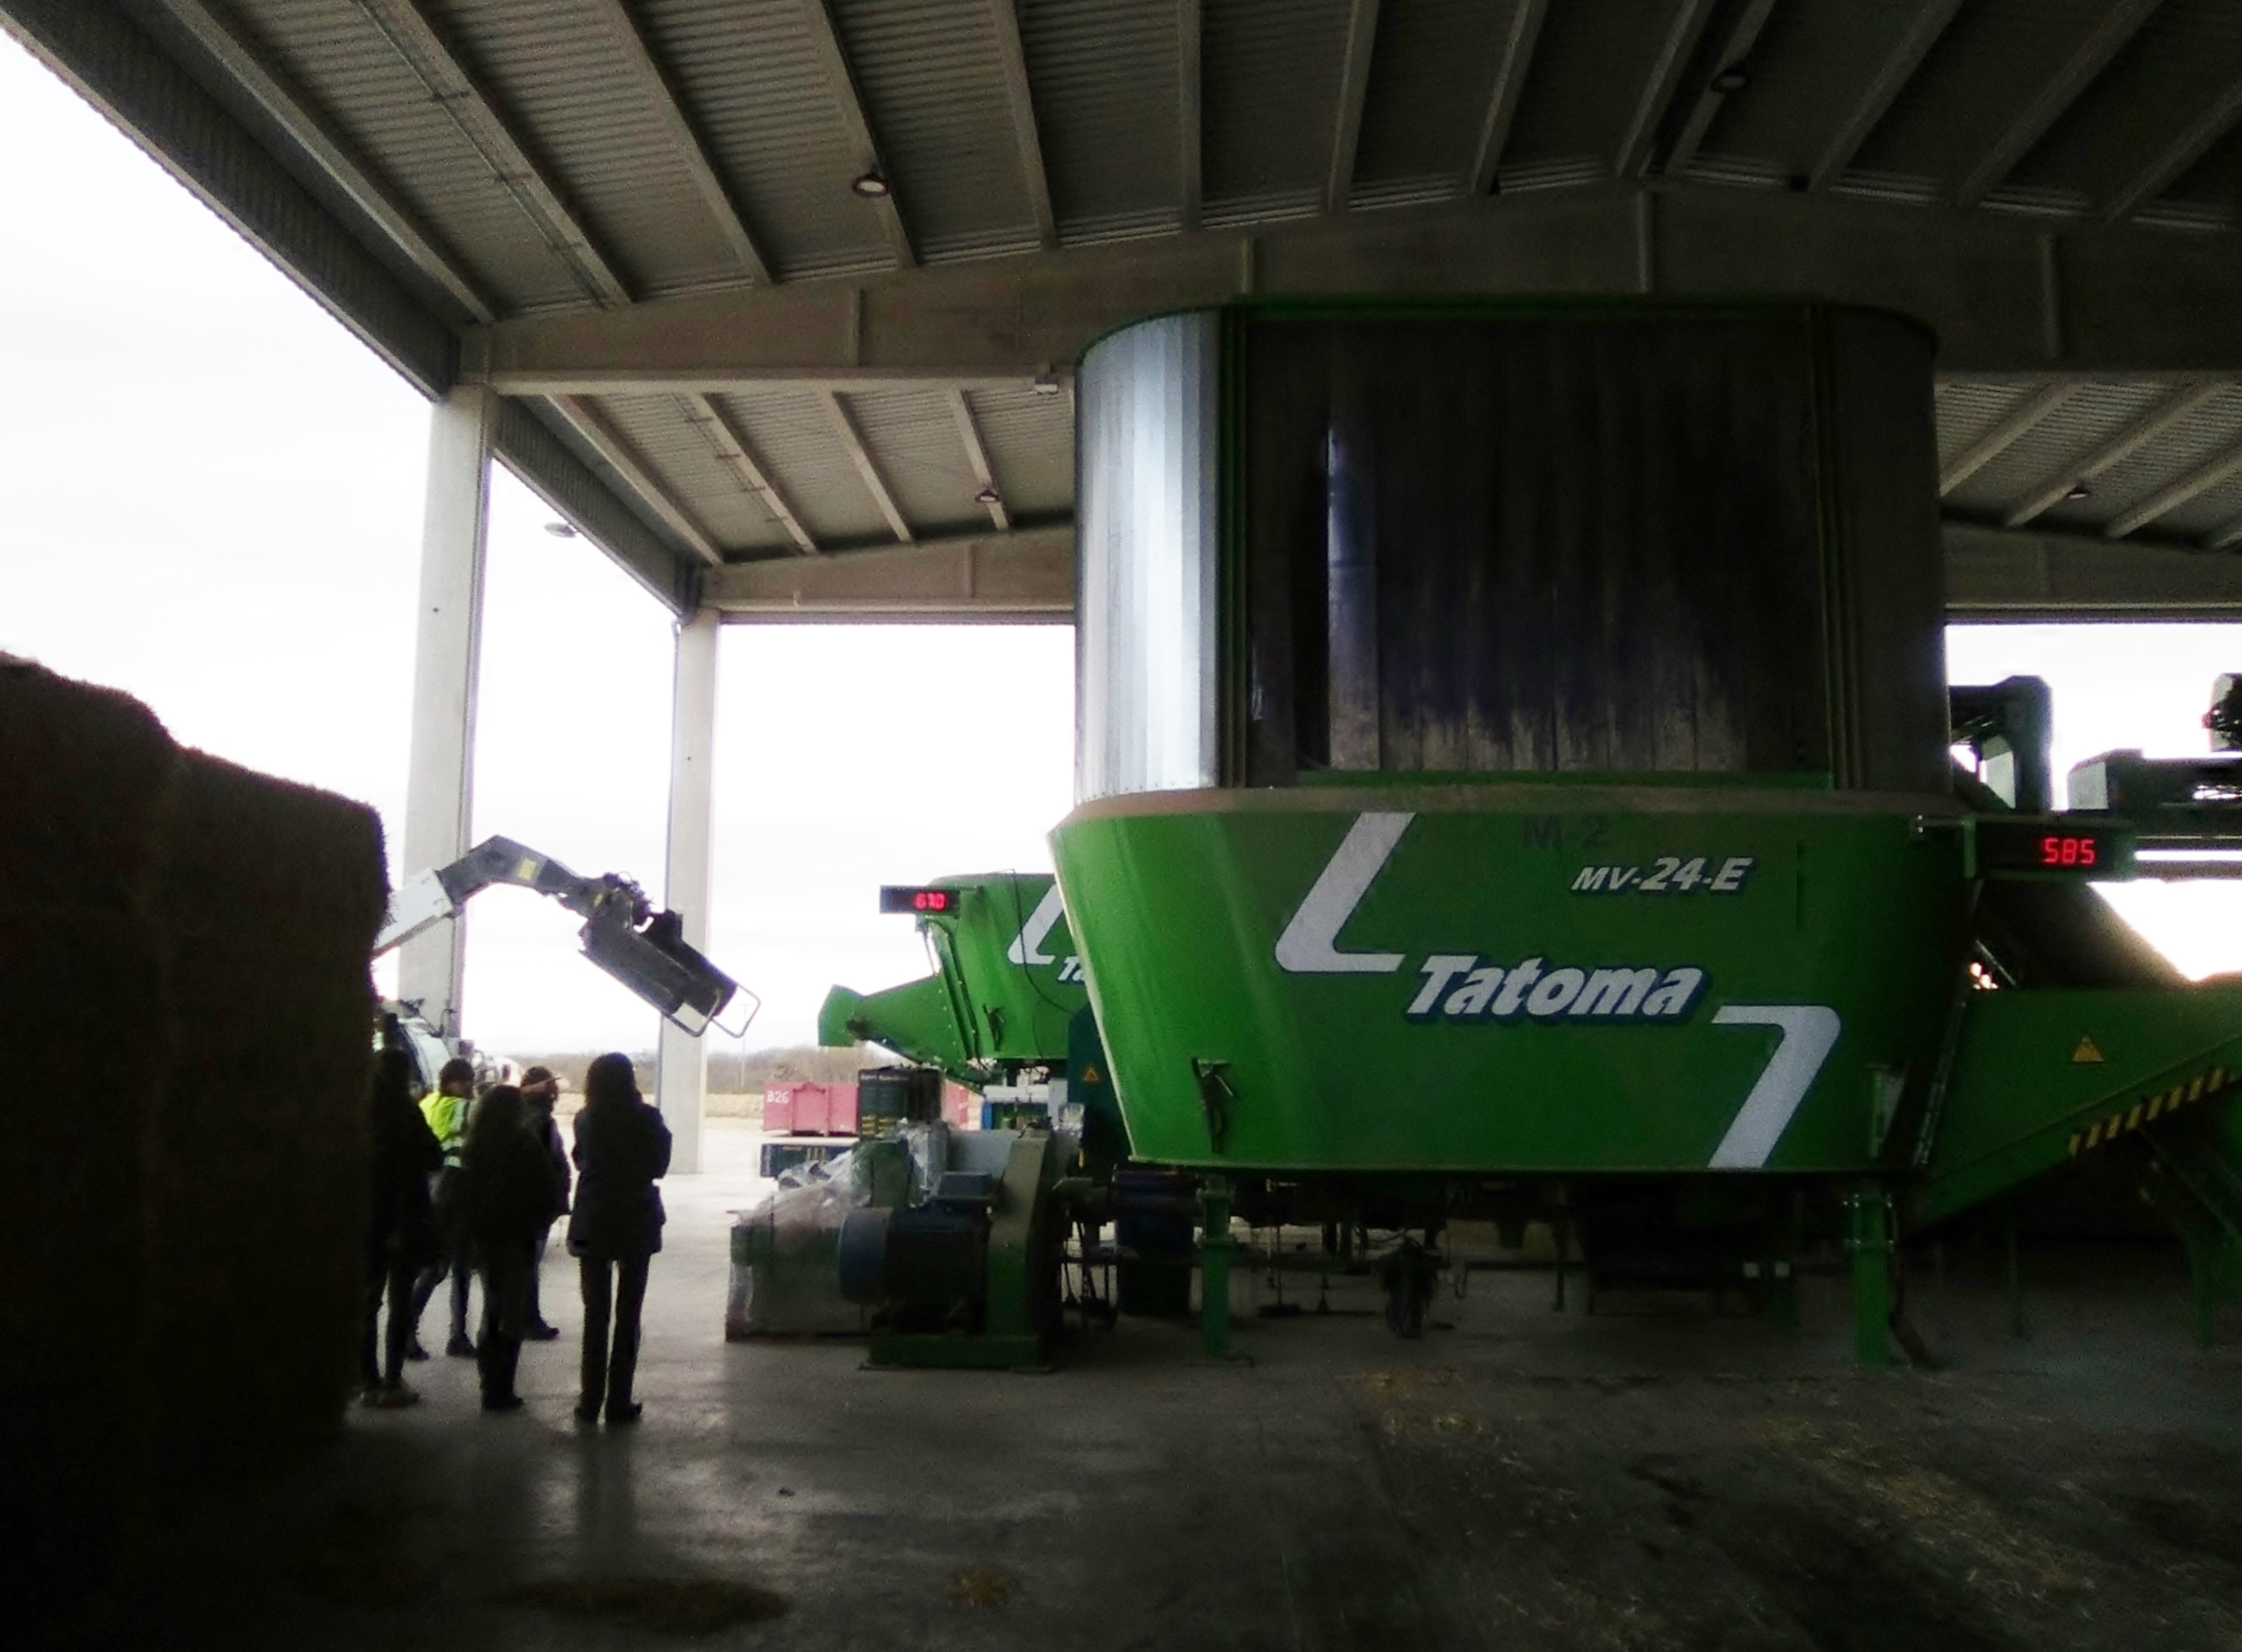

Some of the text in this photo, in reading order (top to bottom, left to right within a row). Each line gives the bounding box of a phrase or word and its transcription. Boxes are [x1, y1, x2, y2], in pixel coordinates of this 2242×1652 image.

[2044, 837, 2096, 864] 585
[1570, 856, 1753, 890] MV-24-E
[1407, 955, 1703, 1016] Tatoma
